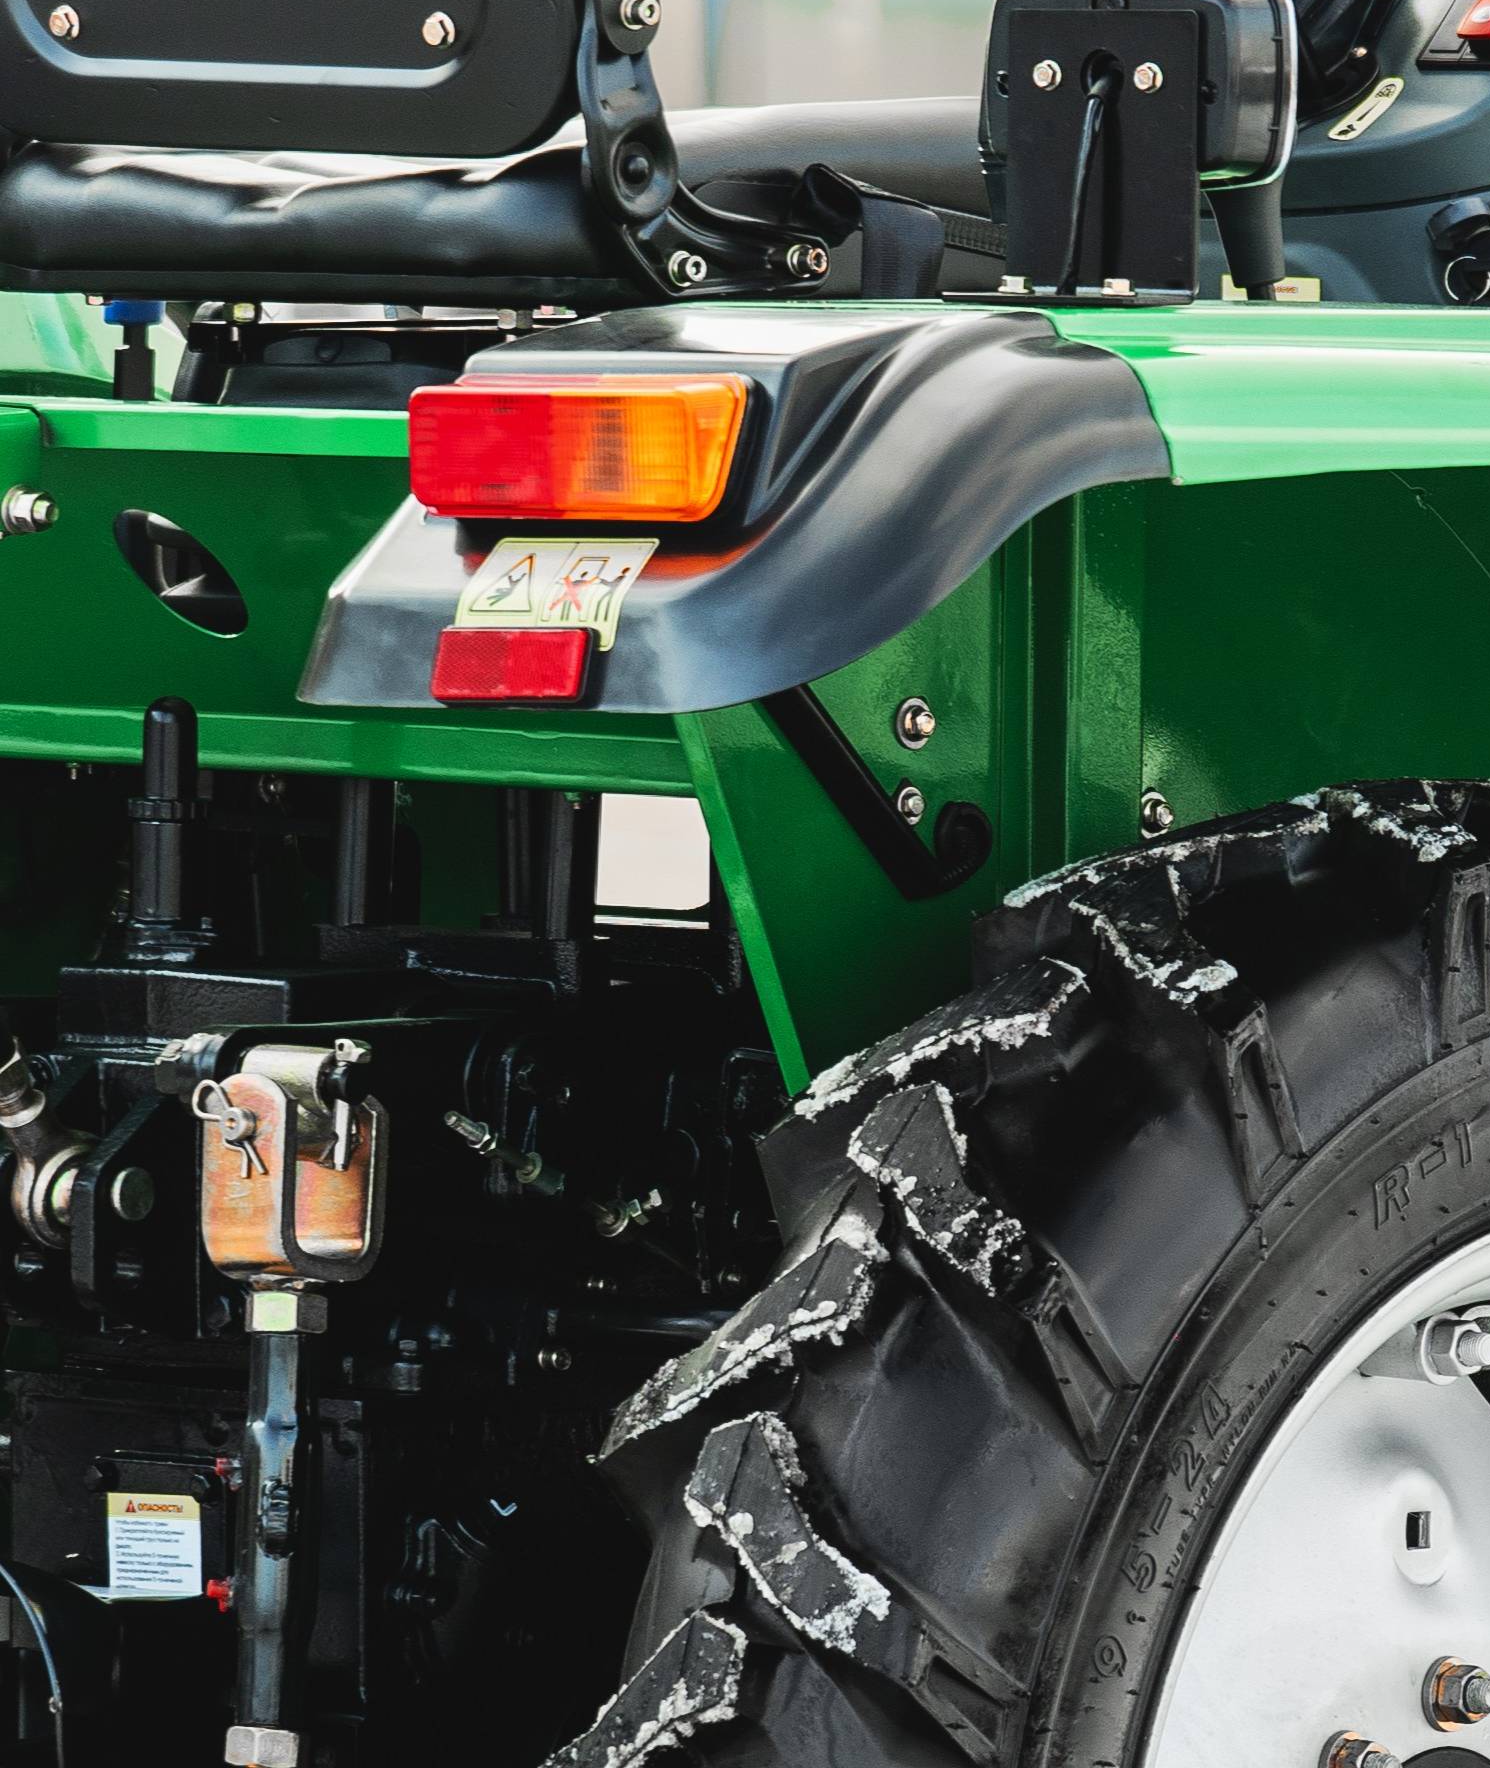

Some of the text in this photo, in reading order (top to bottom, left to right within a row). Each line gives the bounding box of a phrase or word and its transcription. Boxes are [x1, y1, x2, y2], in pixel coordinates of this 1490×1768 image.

[1374, 1121, 1474, 1230] R-1
[1165, 1528, 1192, 1579] TUBE
[1220, 1398, 1258, 1463] NYLON
